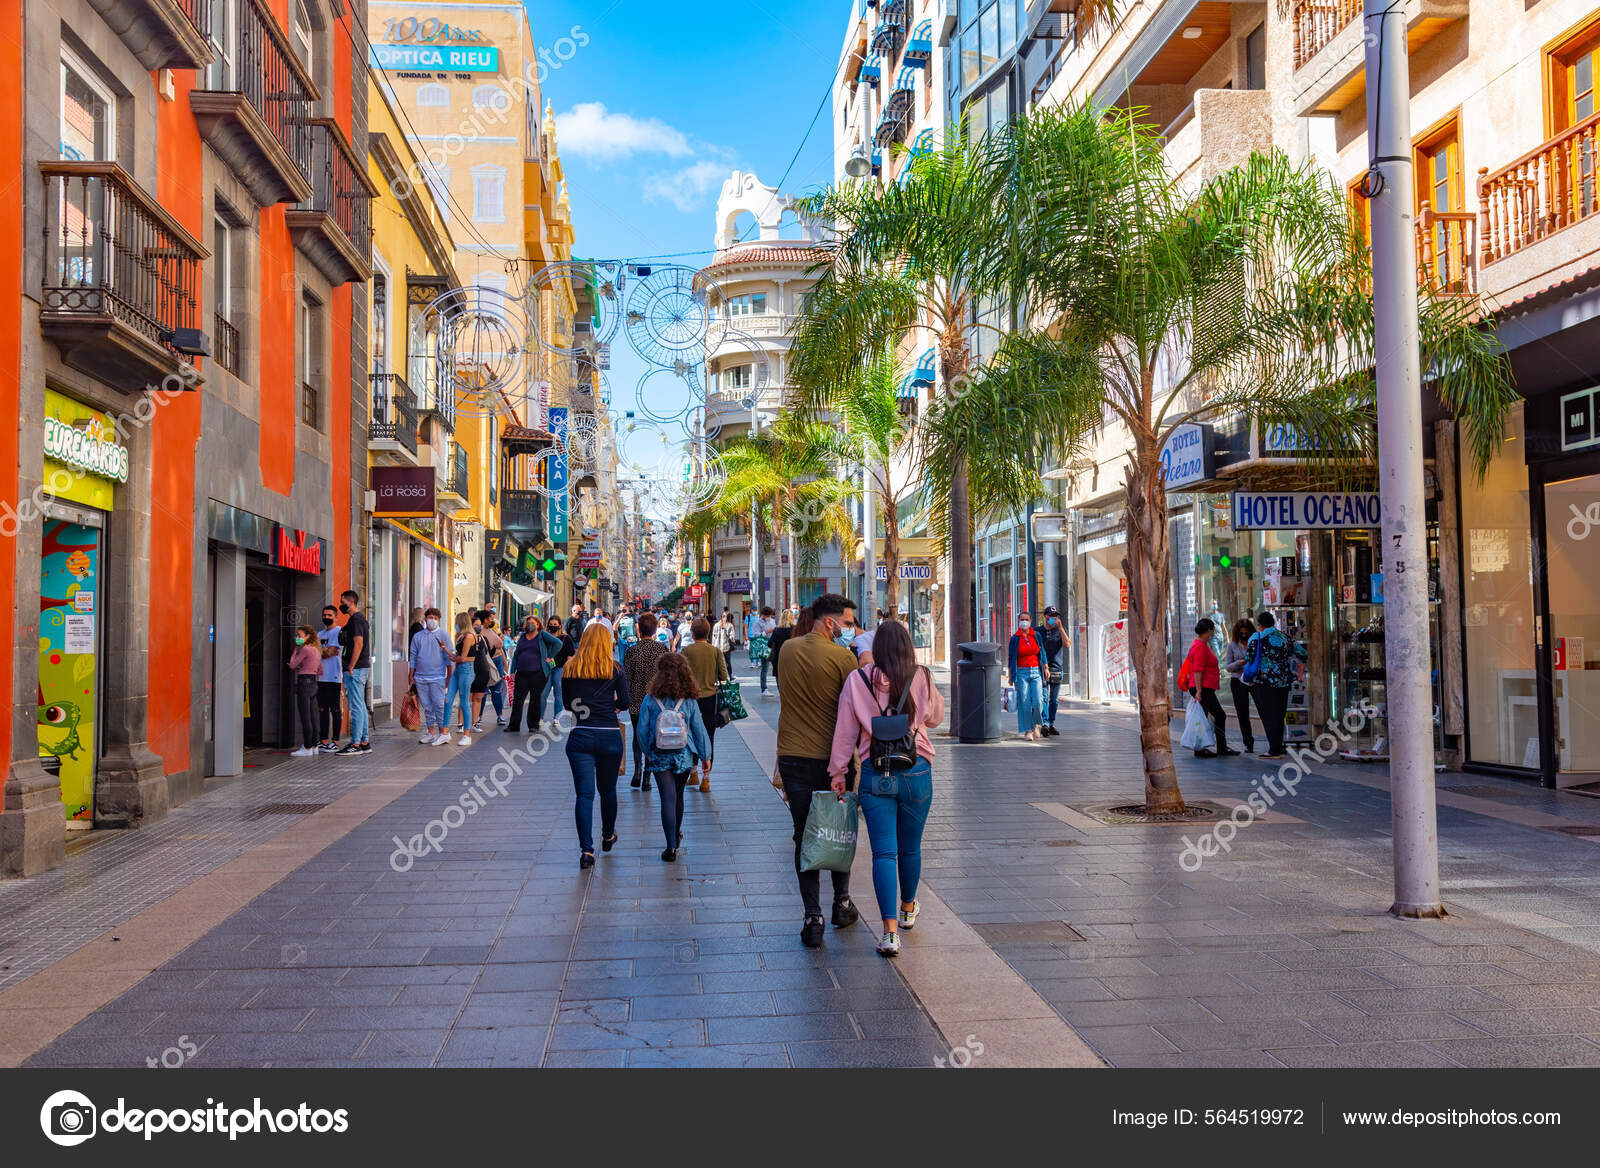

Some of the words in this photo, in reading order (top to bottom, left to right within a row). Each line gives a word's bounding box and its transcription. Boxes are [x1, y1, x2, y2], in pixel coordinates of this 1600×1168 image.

[382, 16, 440, 42] 100
[427, 24, 481, 42] Años
[378, 51, 443, 65] OPTICA
[450, 52, 491, 66] RIEU
[1570, 412, 1584, 428] MI
[1172, 429, 1201, 453] HOTEL
[1240, 496, 1299, 526] HOTEL
[1303, 495, 1381, 525] OCEANO
[489, 537, 500, 550] 7
[1393, 535, 1402, 547] 7
